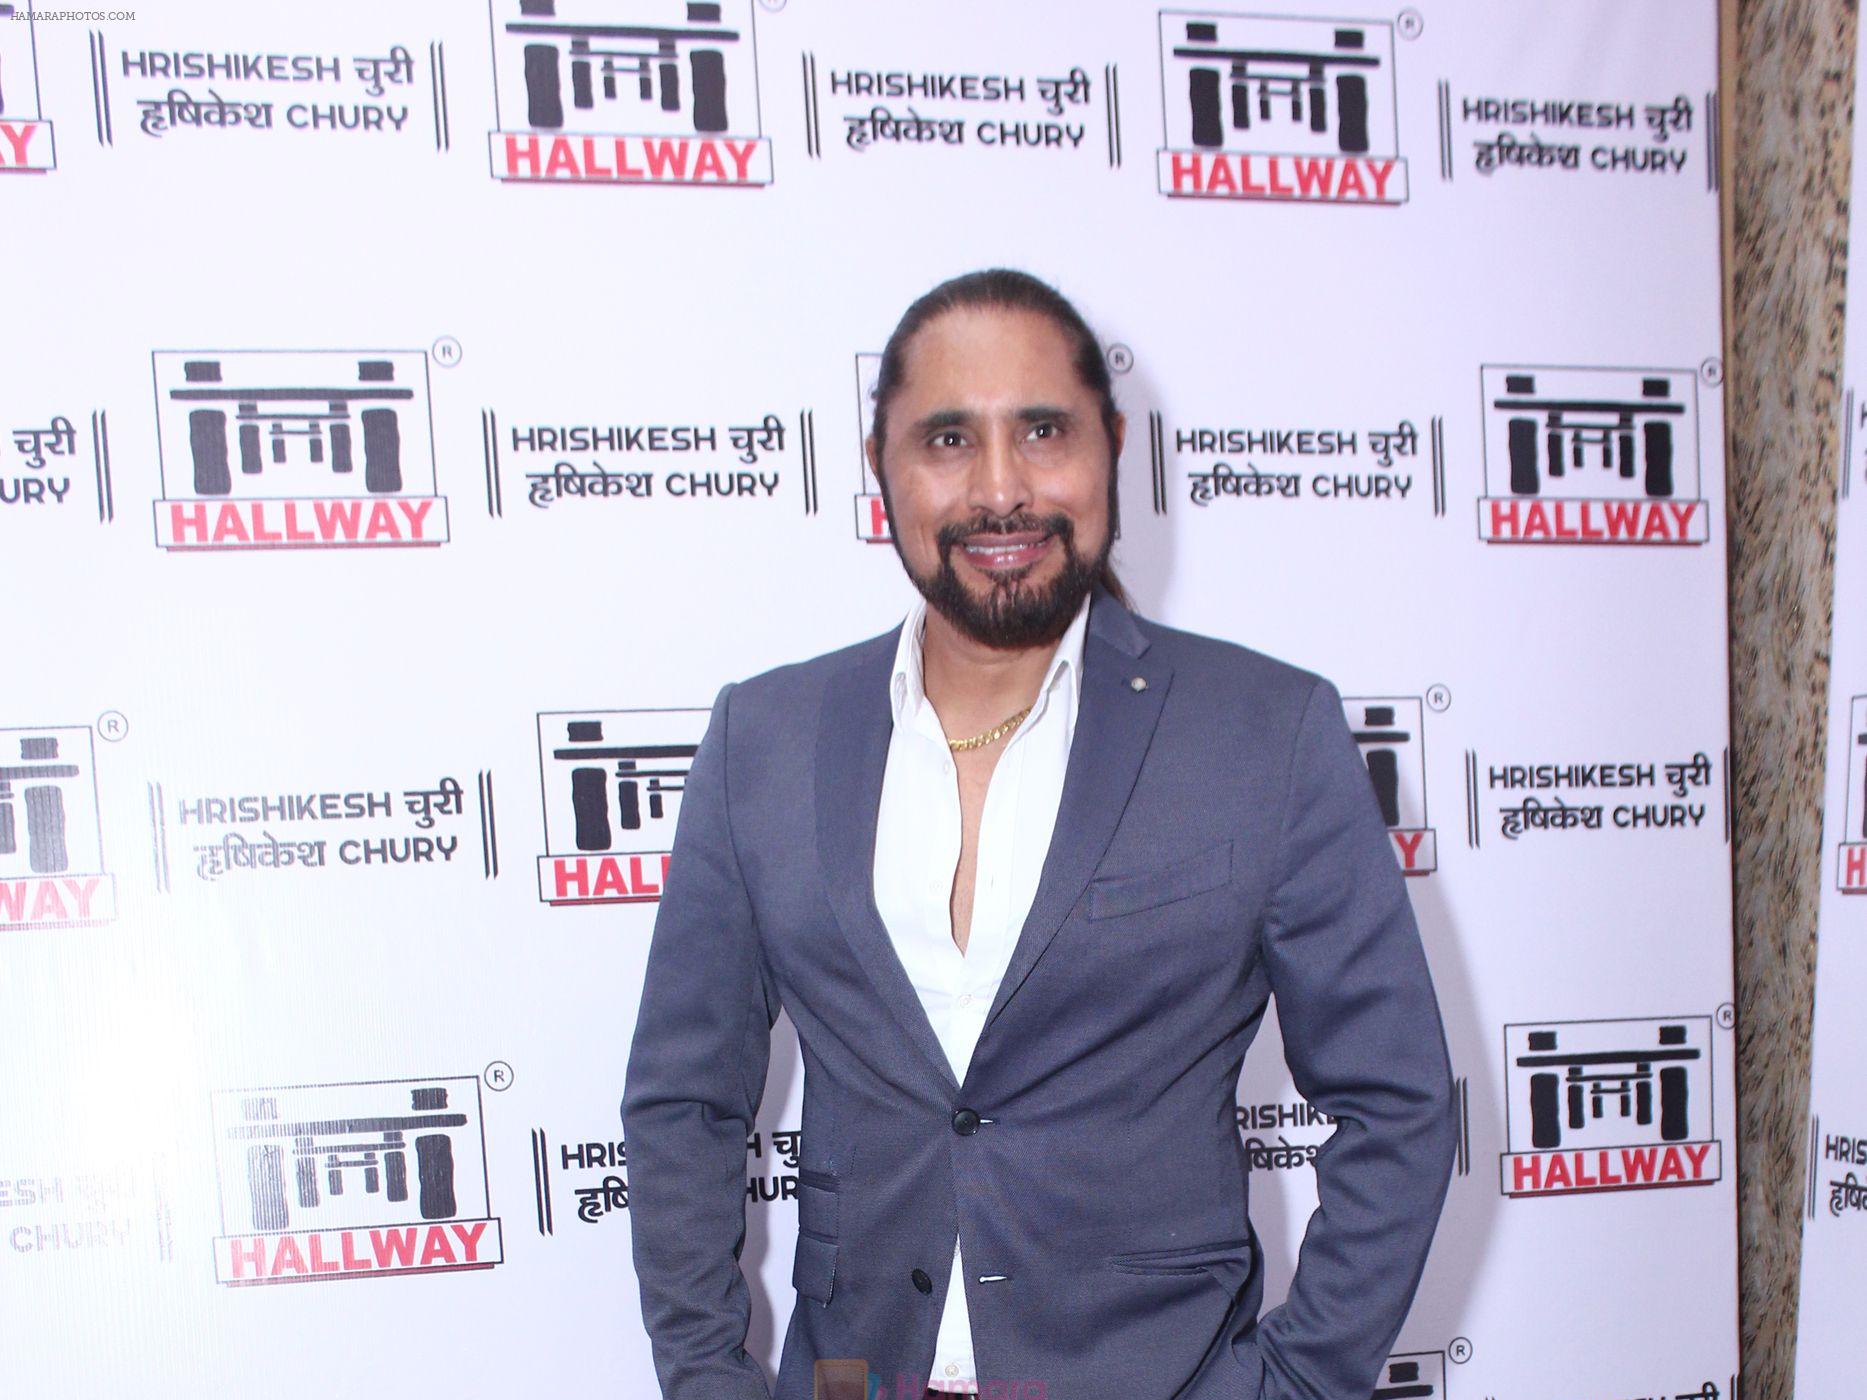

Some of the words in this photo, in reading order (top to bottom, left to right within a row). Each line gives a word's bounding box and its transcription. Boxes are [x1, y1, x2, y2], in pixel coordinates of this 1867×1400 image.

[122, 51, 340, 82] HRISHIKESH
[353, 46, 414, 97] चुरी
[831, 71, 1024, 101] HRISHIKESH
[1037, 68, 1090, 116] चुरी
[287, 104, 408, 131] CHURY
[977, 122, 1084, 148] CHURY
[1463, 98, 1634, 128] HRISHIKESH
[1645, 96, 1693, 143] चुरी
[505, 137, 757, 181] HALLWAY
[1171, 156, 1395, 199] HALLWAY
[1591, 147, 1686, 173] CHURY
[13, 416, 76, 469] चुरी
[512, 427, 716, 451] HRISHIKESH
[729, 415, 785, 464] चुरी
[1177, 430, 1357, 454] HRISHIKESH
[1368, 421, 1418, 467] चुरी
[666, 472, 779, 496] CHURY
[1312, 475, 1411, 498] CHURY
[171, 498, 433, 541] HALLWAY
[1491, 499, 1696, 540] HALLWAY
[1490, 764, 1655, 788] HRISHIKESH
[1665, 752, 1712, 798] चुरी
[179, 790, 392, 825] HRISHIKESH
[1613, 805, 1705, 828] CHURY
[339, 836, 457, 864] CHURY
[1514, 1145, 1711, 1192] HALLWAY
[230, 1223, 487, 1279] HALLWAY
